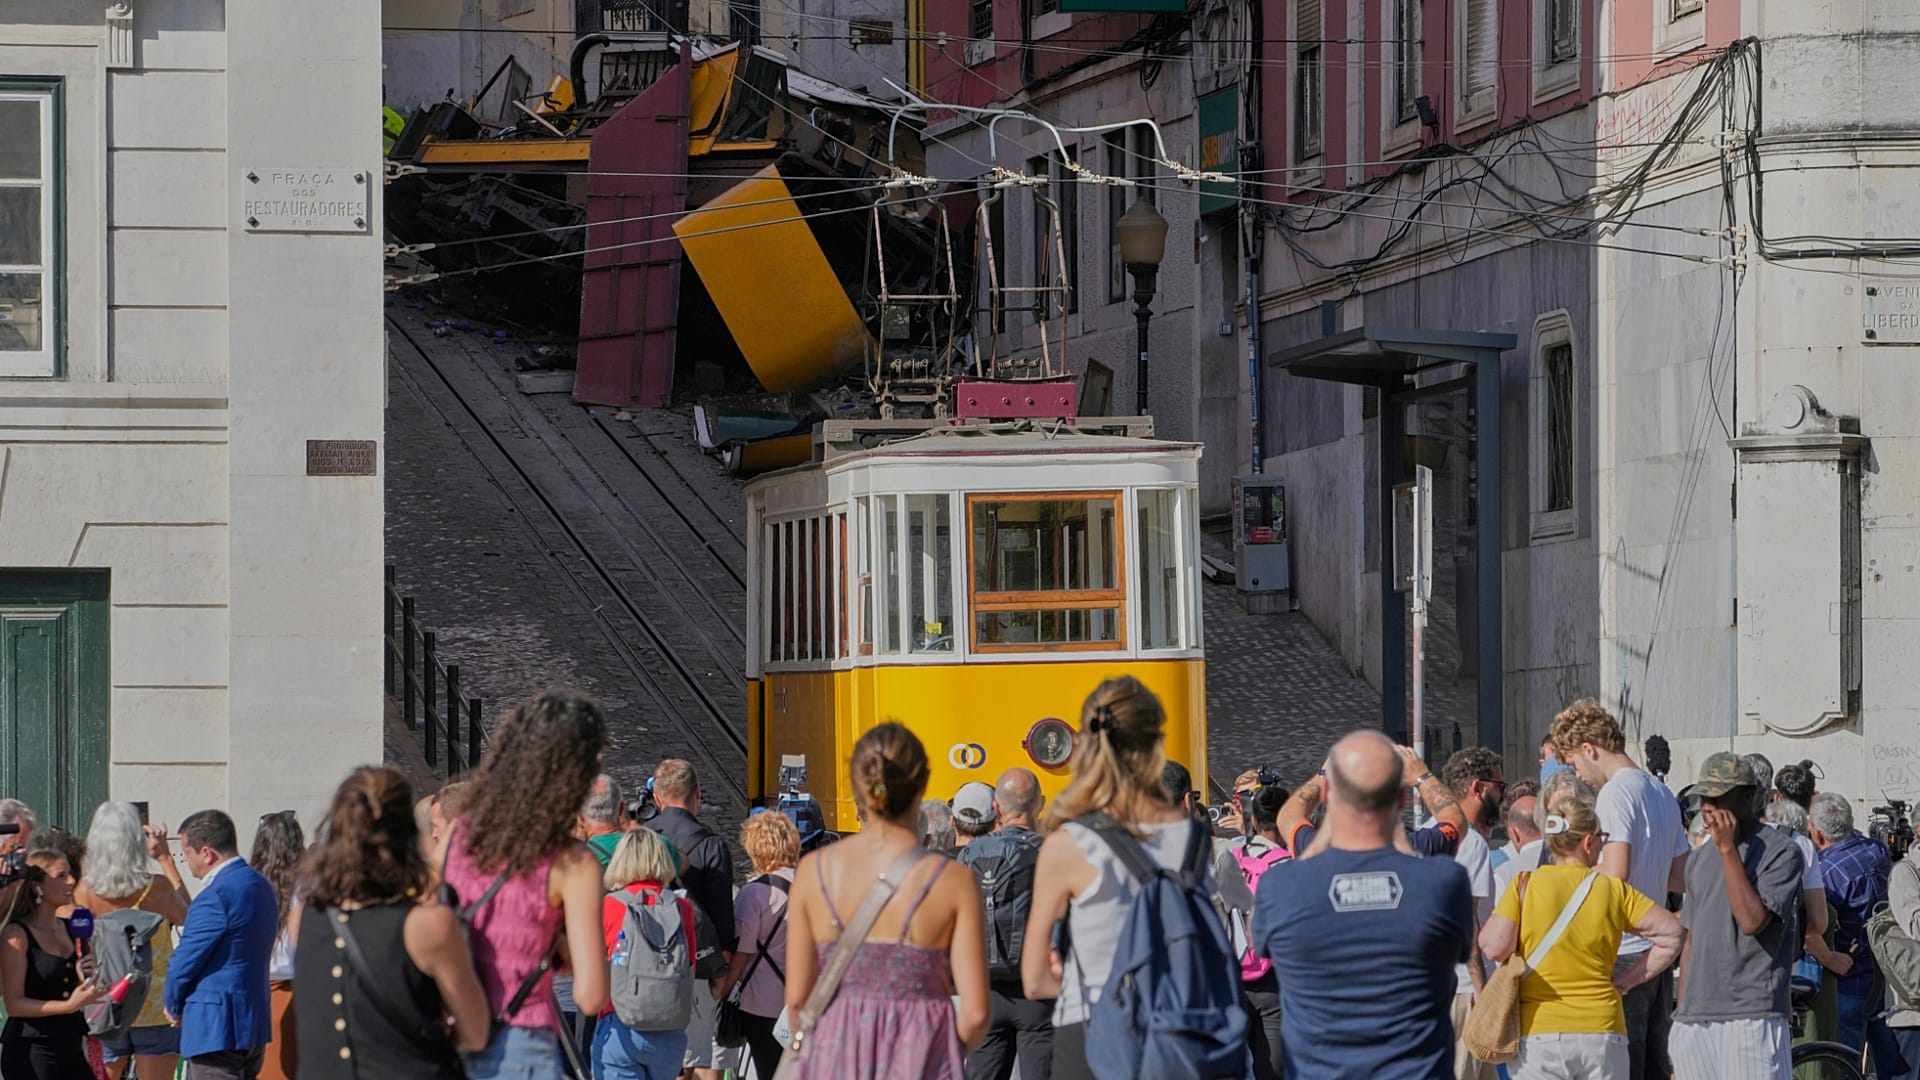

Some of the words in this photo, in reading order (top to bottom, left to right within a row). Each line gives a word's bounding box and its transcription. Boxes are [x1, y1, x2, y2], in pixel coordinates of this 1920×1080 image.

[1202, 129, 1237, 169] SUBWAY
[272, 173, 336, 188] PRAÇA
[292, 189, 317, 197] DOS
[244, 201, 365, 217] RESTAURADORES
